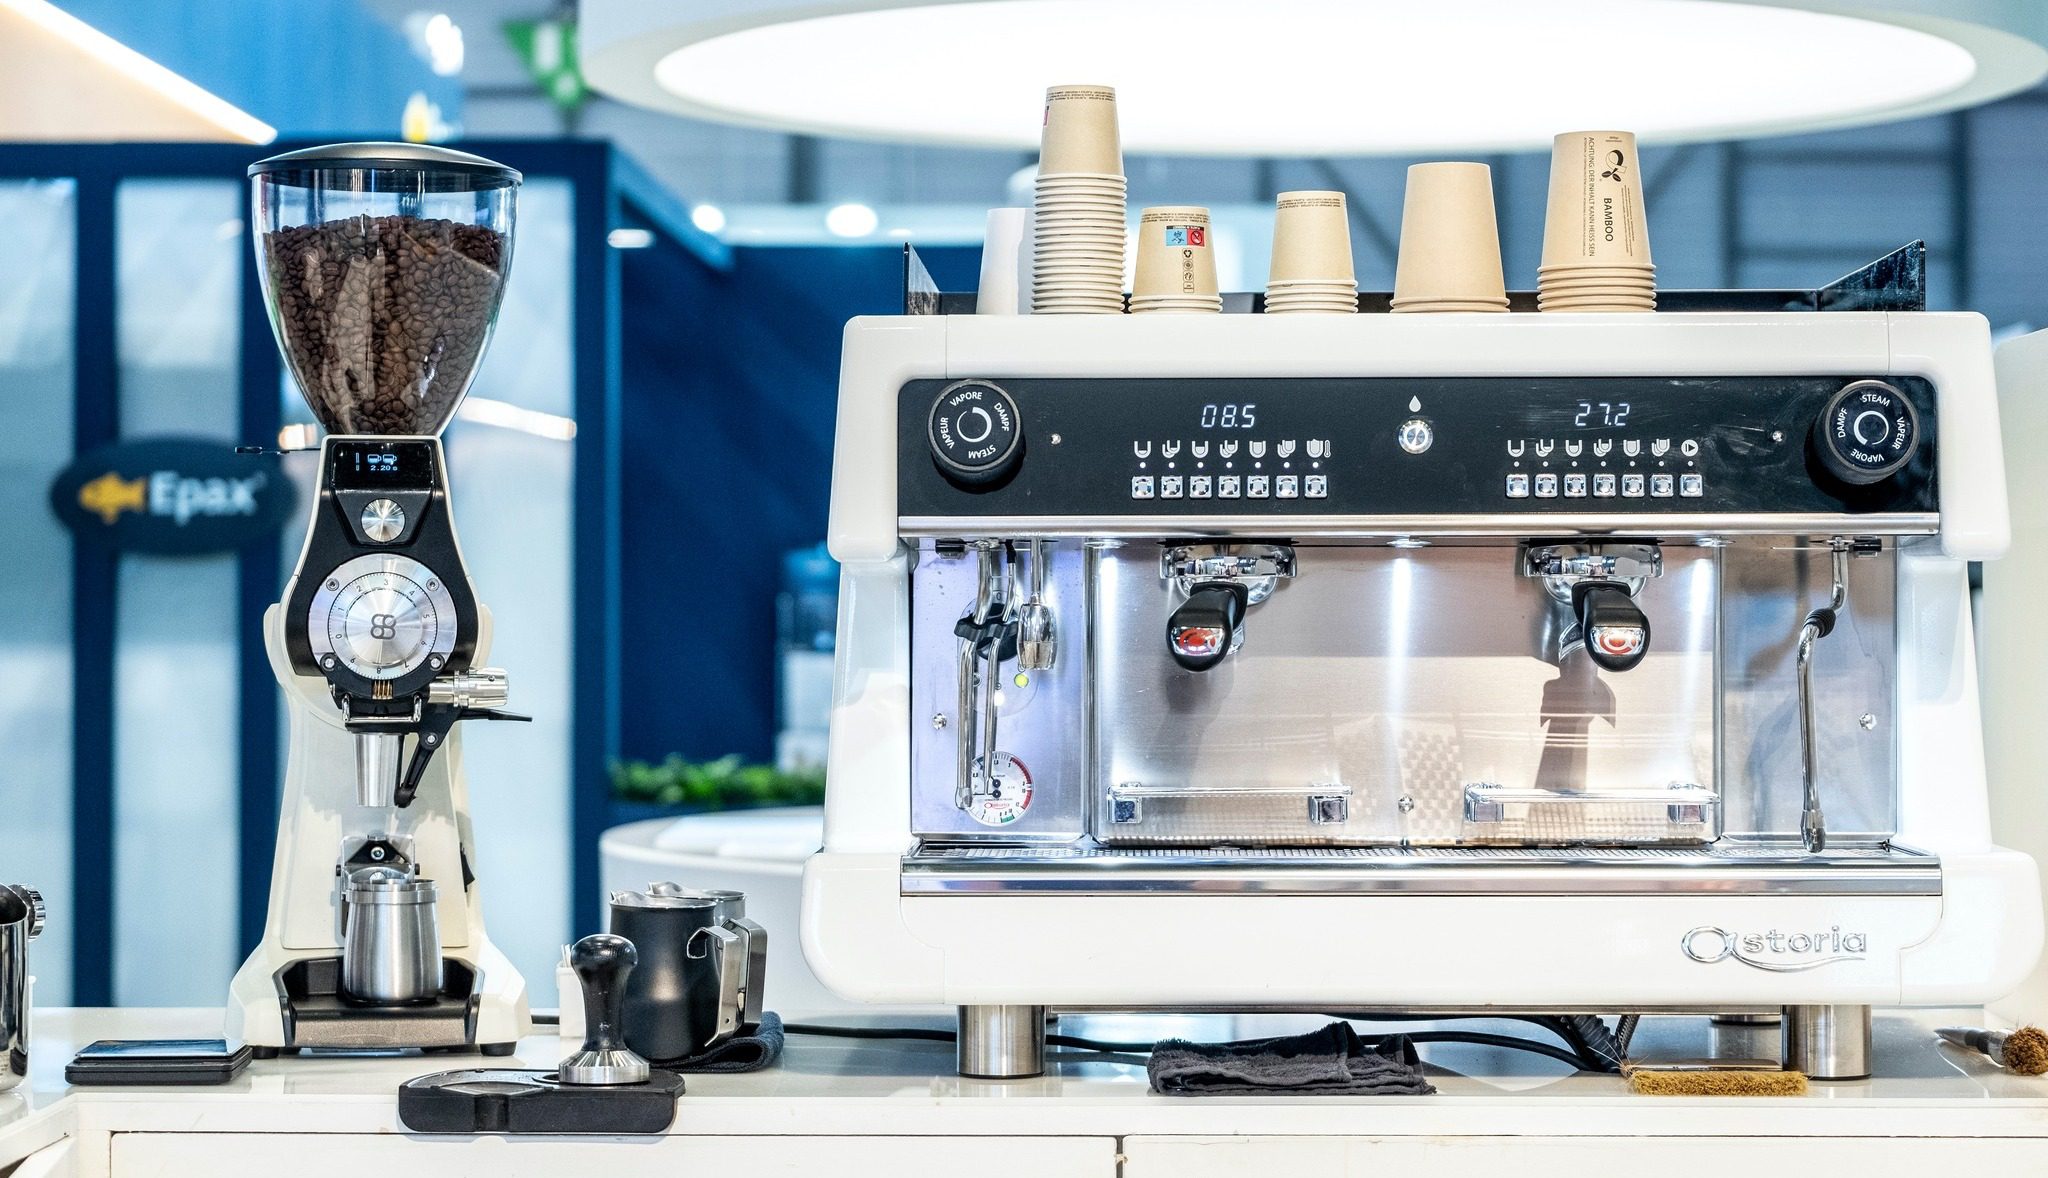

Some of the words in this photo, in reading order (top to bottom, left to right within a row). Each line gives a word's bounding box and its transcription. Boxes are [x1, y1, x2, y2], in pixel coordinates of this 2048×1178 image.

[1603, 197, 1614, 242] BAMBOO
[949, 391, 983, 407] VAPORE
[1860, 393, 1891, 407] STEAM
[993, 402, 1010, 432] DAMPF
[1201, 404, 1256, 428] 08.5
[1574, 403, 1630, 426] 27.2
[1836, 407, 1848, 438] DAMPF
[940, 416, 955, 449] VAPEUR
[1891, 416, 1906, 450] VAPEUR
[968, 444, 997, 459] STEAM
[1850, 448, 1885, 463] VAPORE
[149, 470, 257, 527] Epax
[356, 585, 362, 593] 2
